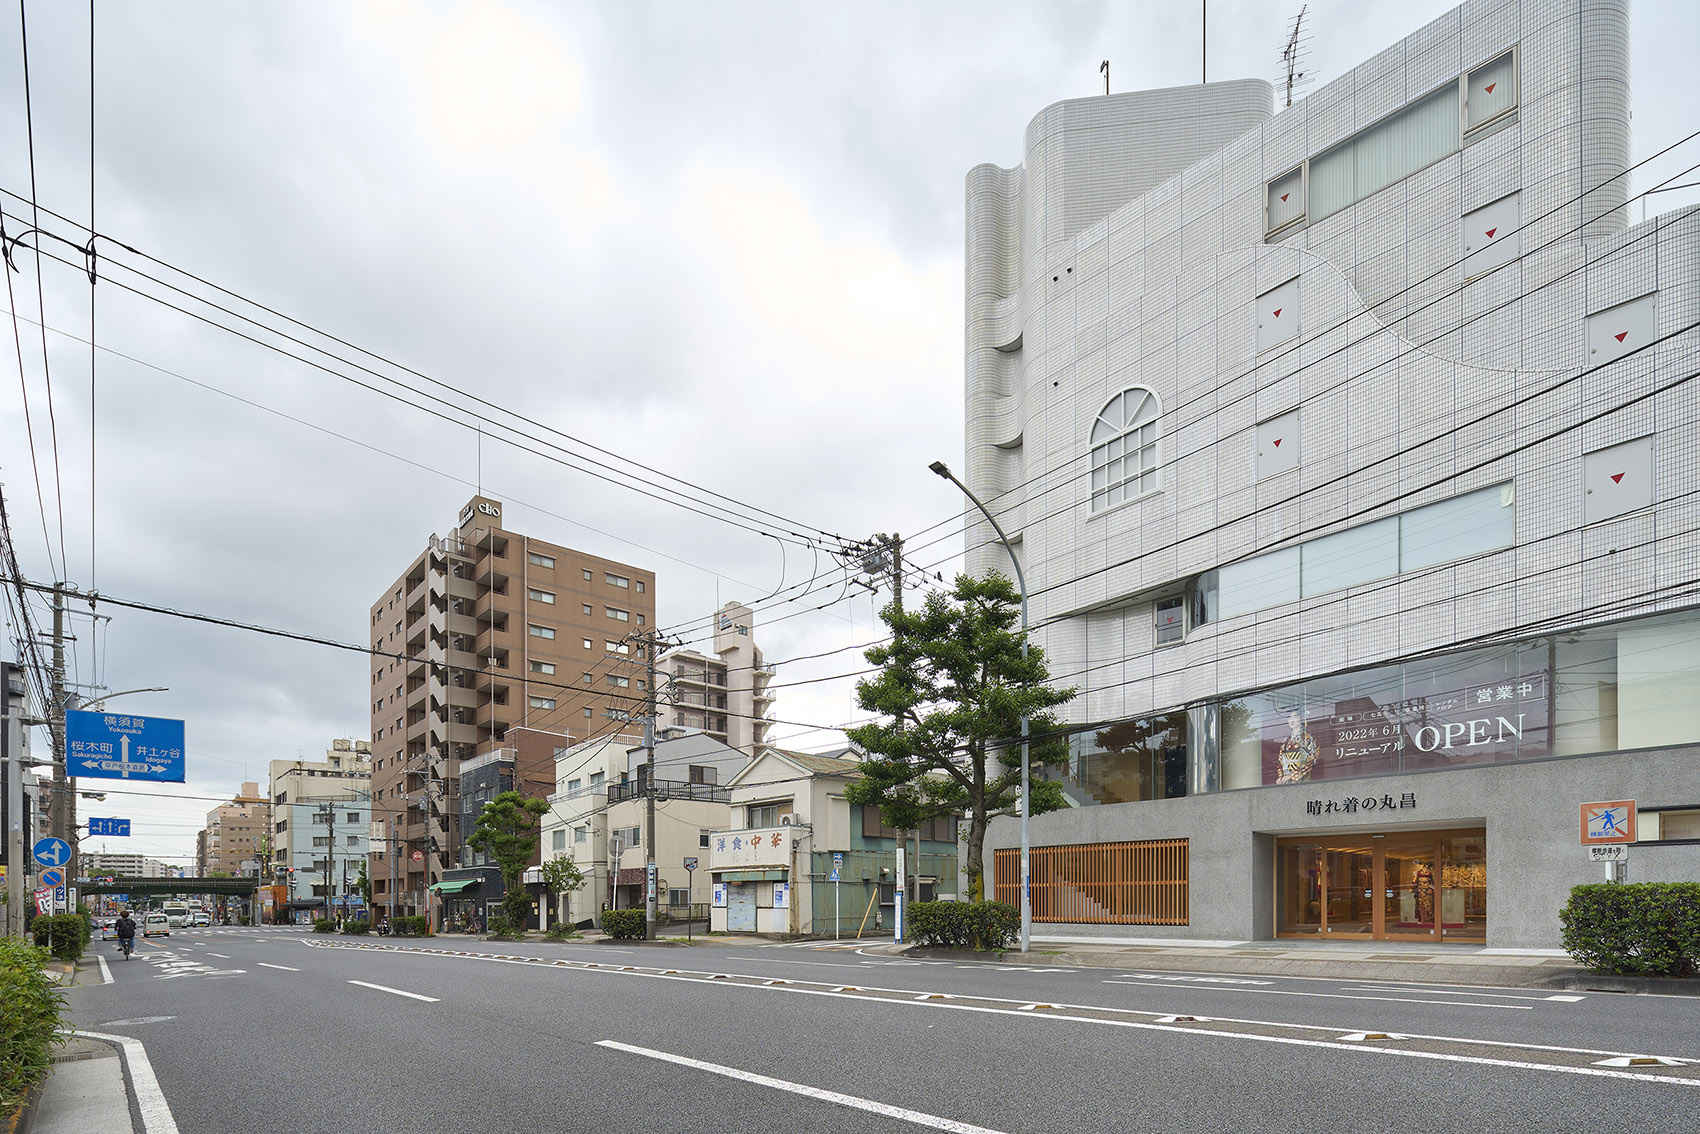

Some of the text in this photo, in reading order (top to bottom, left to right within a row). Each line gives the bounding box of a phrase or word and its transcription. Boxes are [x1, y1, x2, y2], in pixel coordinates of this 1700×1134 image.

[1476, 682, 1532, 704] 営業中
[103, 715, 145, 729] 横須賀
[108, 726, 142, 735] Yokosuka
[1338, 724, 1401, 742] 2022年 6月
[1415, 713, 1526, 752] OPEN
[70, 740, 114, 754] 桜木町
[1335, 739, 1406, 760] リニューアル
[72, 751, 113, 760] Sakuragicho
[145, 756, 172, 765] Idogaya
[1306, 792, 1417, 816] 晴れ着の丸昌
